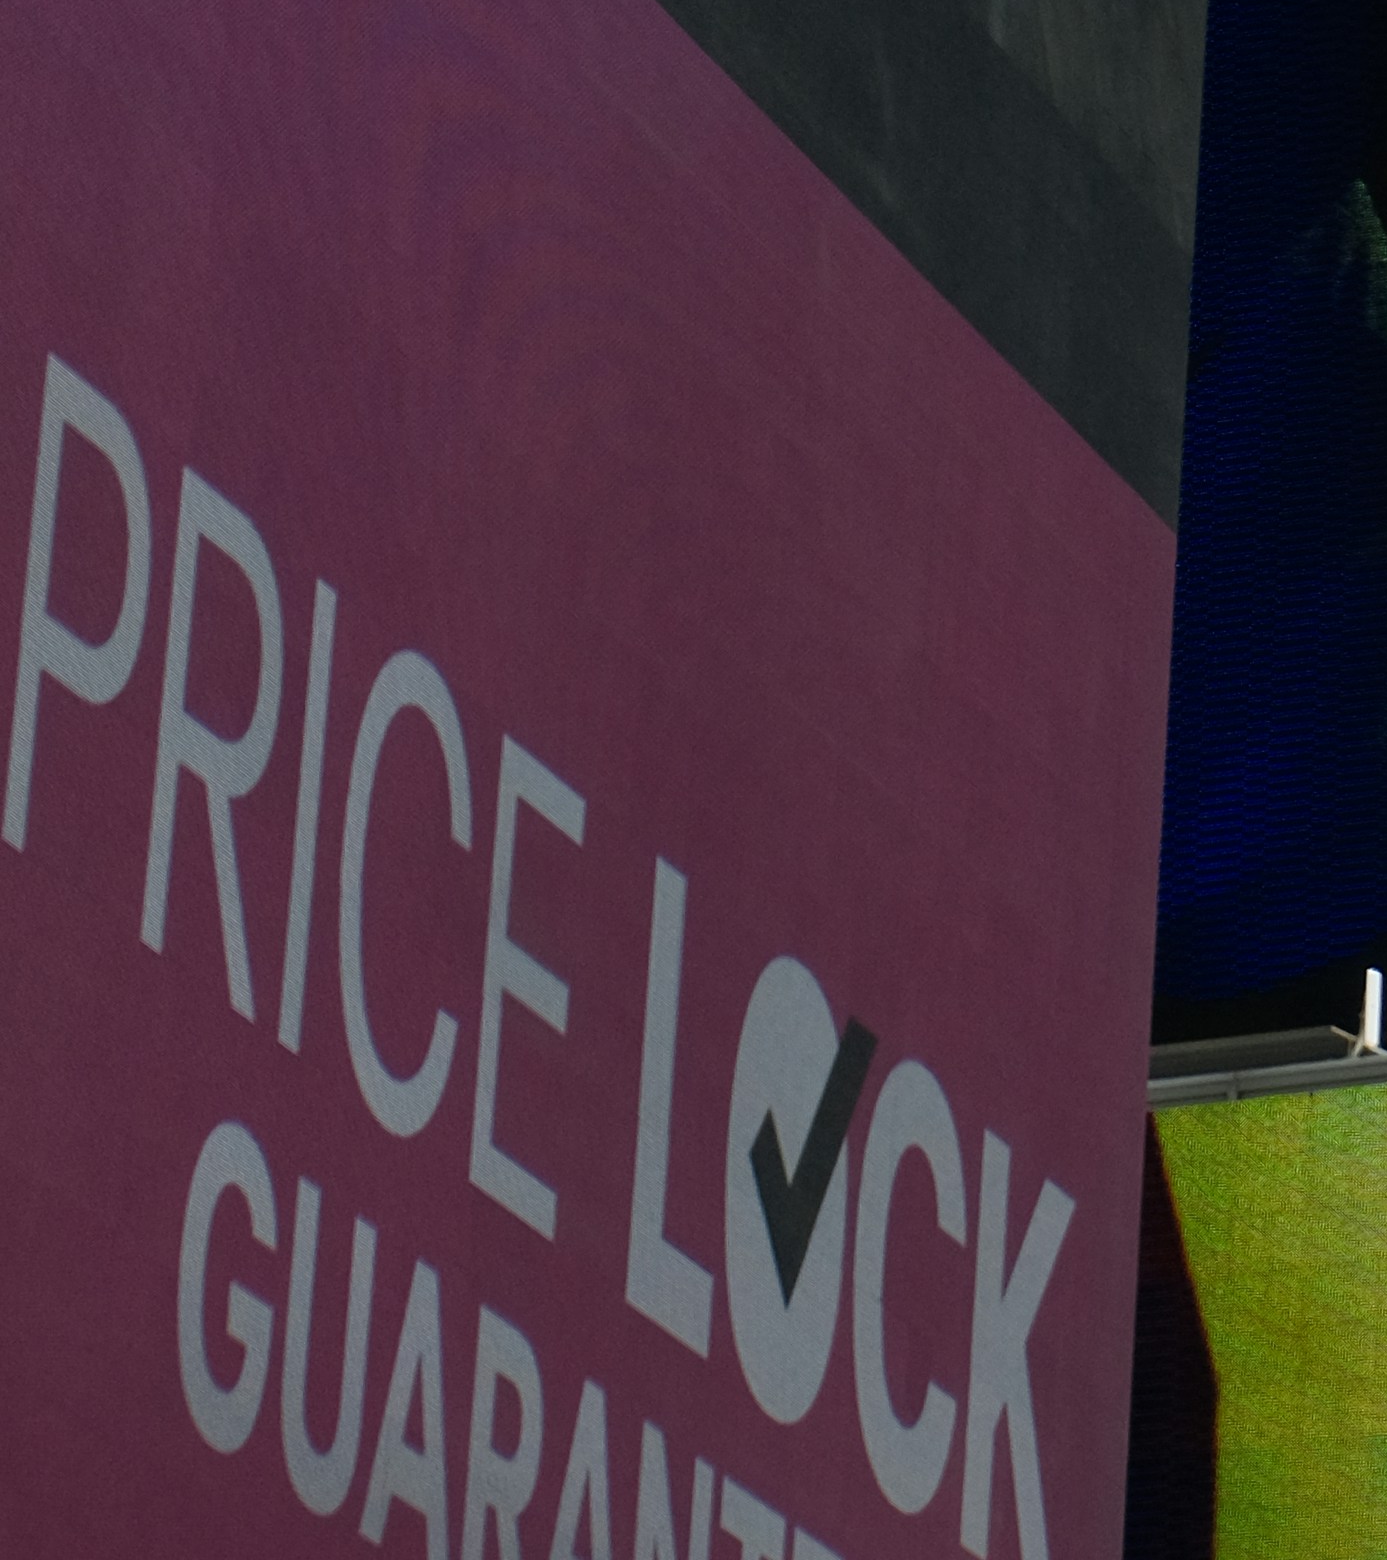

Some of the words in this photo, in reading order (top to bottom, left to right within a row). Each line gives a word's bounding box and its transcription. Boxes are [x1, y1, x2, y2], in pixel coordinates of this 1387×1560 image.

[1, 351, 587, 1242] PRICE
[624, 855, 1077, 1560] LOCK
[176, 1120, 846, 1560] GUARA
